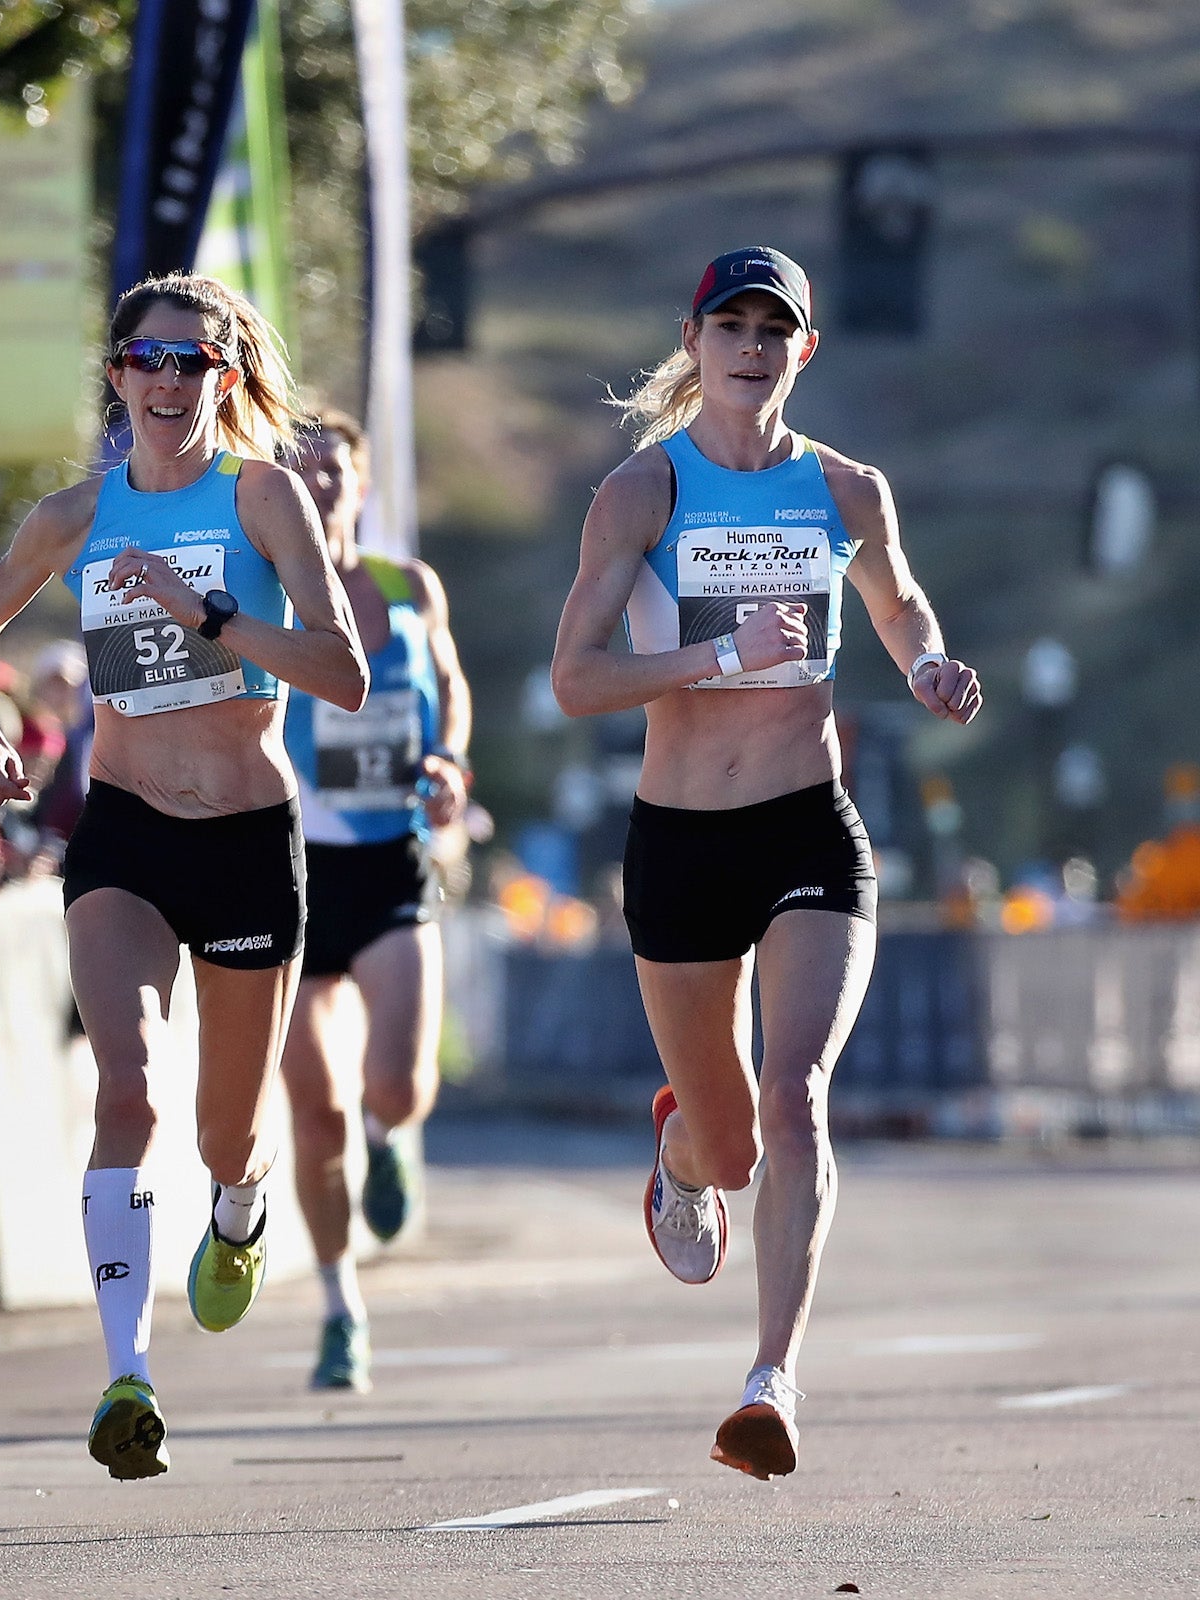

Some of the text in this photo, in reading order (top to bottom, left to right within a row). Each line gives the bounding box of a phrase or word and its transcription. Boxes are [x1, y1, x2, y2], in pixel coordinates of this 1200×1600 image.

[774, 509, 813, 521] HOKA
[173, 529, 214, 543] HOKA
[726, 531, 783, 544] Humana
[691, 547, 753, 562] Rock
[771, 546, 819, 560] Roll
[710, 562, 803, 571] ARIZONA
[703, 583, 811, 594] HALF MARATHON
[105, 611, 135, 625] HALF
[133, 623, 190, 666] 52
[145, 665, 187, 683] ELITE
[204, 933, 272, 953] HOKA ONE
[254, 940, 273, 949] ONE
